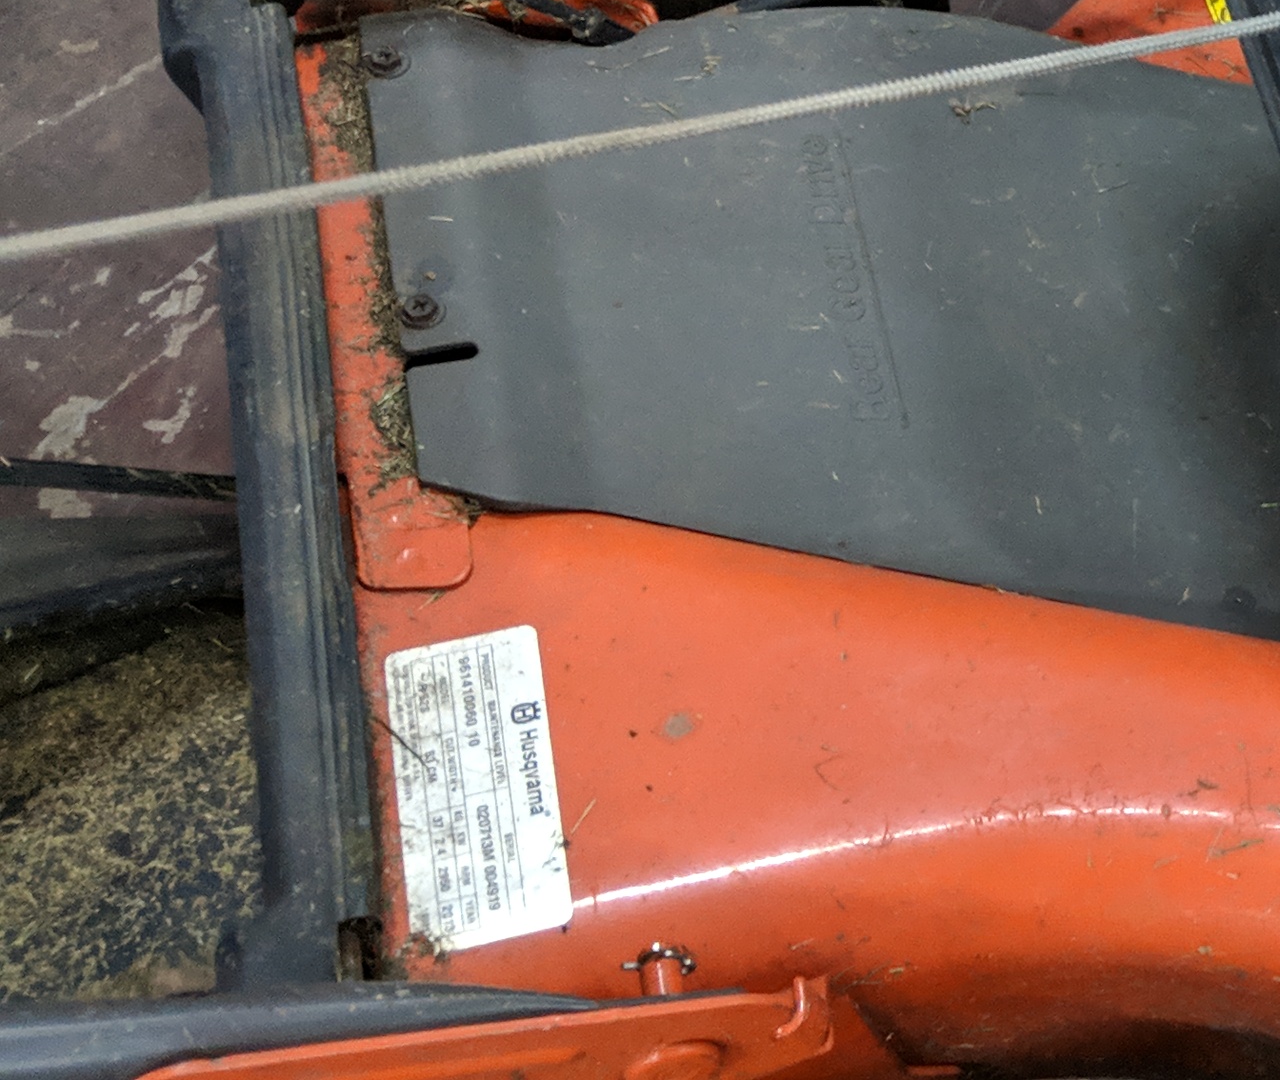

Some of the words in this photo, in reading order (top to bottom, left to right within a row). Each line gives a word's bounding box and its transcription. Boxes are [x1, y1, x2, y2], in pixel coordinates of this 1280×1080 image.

[800, 134, 844, 226] Drive
[822, 237, 866, 322] Gear
[843, 334, 891, 422] Rear
[468, 731, 480, 747] 10
[494, 759, 506, 784] LEVEL
[519, 728, 545, 816] Husqvarna
[504, 832, 515, 863] SERIAL
[484, 865, 501, 911] 004919
[465, 899, 475, 924] YEAR
